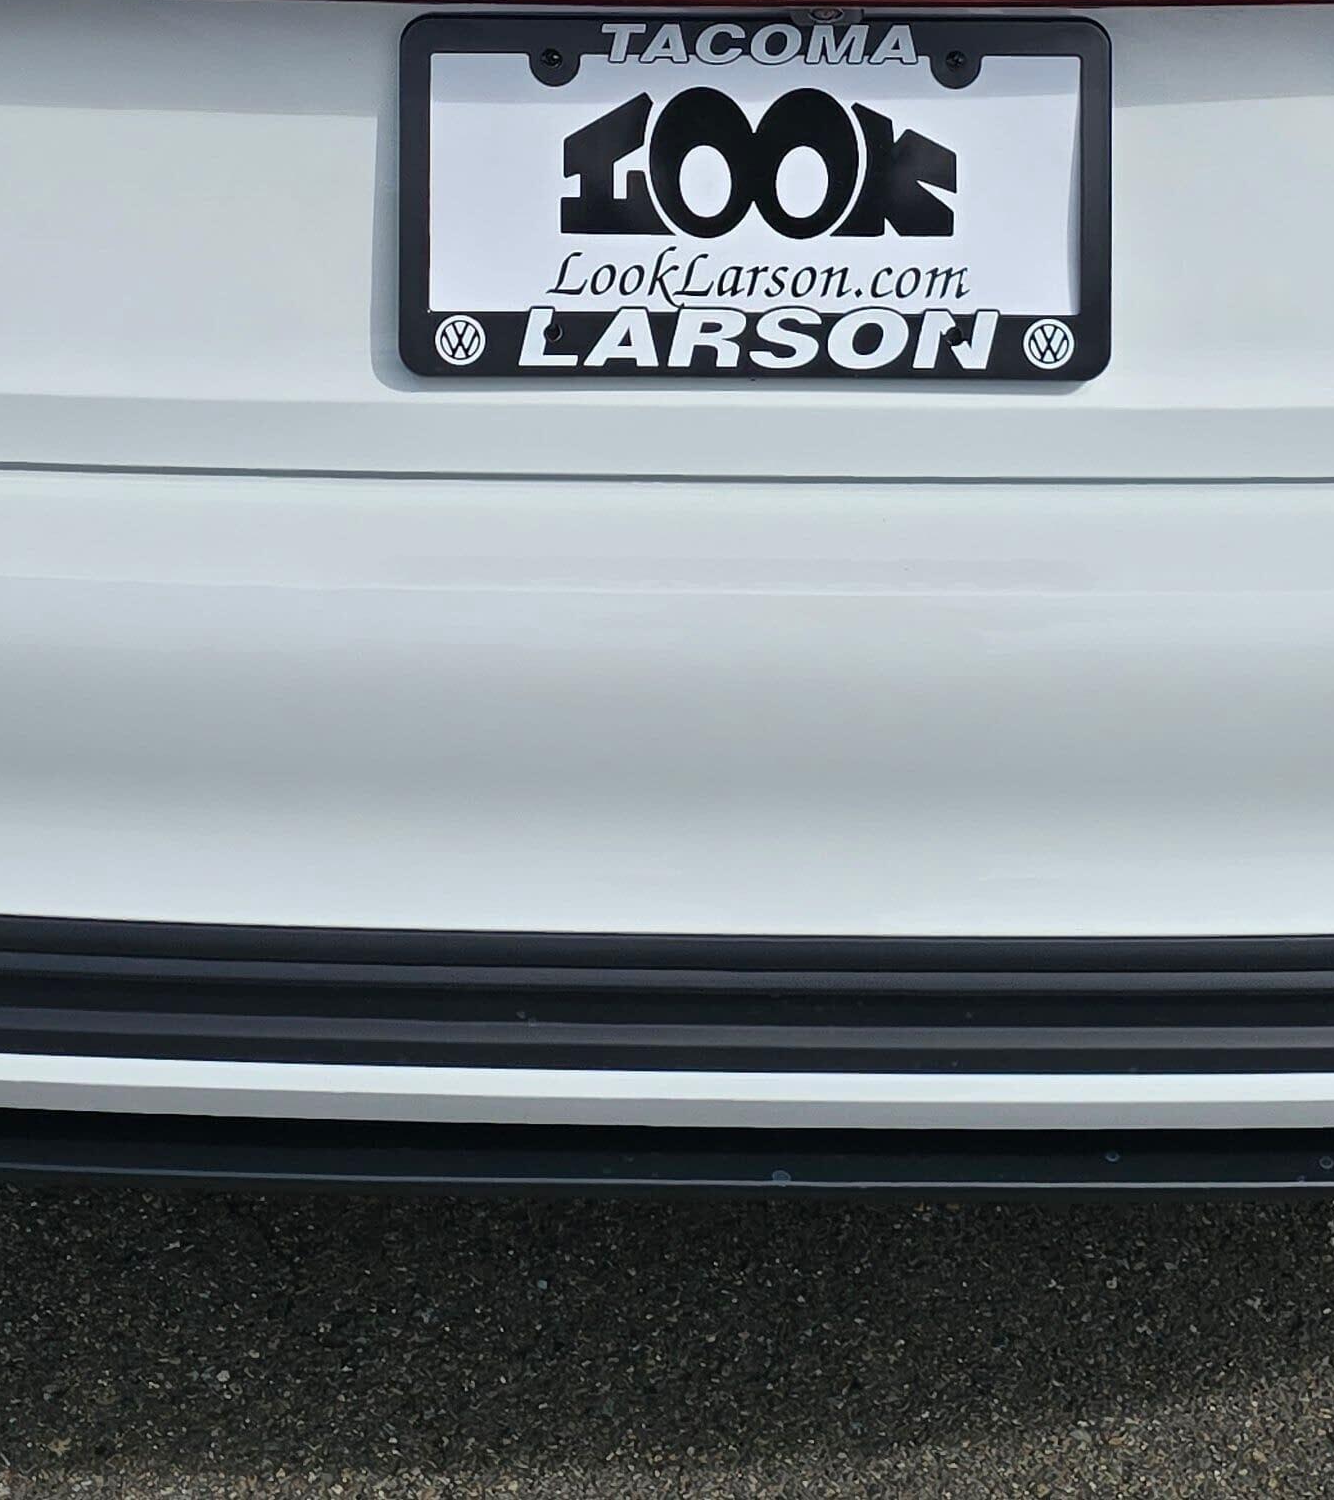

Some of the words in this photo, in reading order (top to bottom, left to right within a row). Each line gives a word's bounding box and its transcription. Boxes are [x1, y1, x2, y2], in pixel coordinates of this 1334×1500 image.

[600, 23, 919, 65] TACOMA
[560, 86, 957, 239] LOOK
[546, 246, 971, 307] LookLarson.com
[518, 305, 999, 370] LARSON
